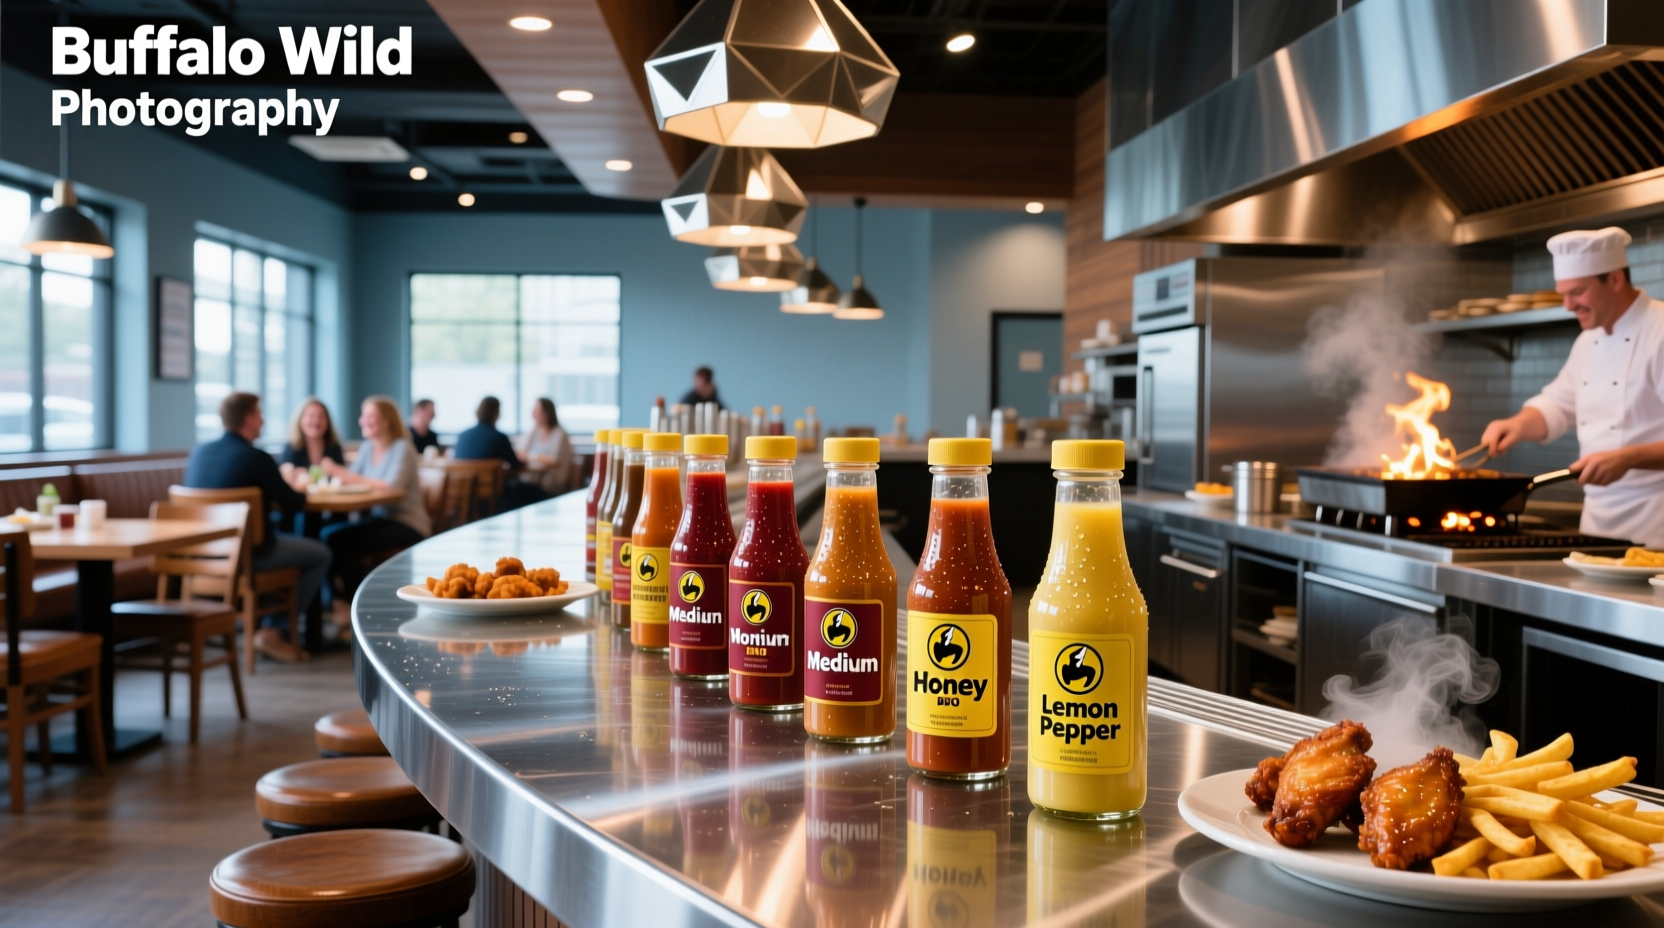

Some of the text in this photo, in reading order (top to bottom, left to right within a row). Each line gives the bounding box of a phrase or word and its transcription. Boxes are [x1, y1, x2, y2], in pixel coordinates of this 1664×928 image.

[807, 650, 879, 673] Medium
[913, 671, 988, 702] Honey
[1042, 694, 1118, 719] Lemon
[1040, 716, 1121, 745] Pepper
